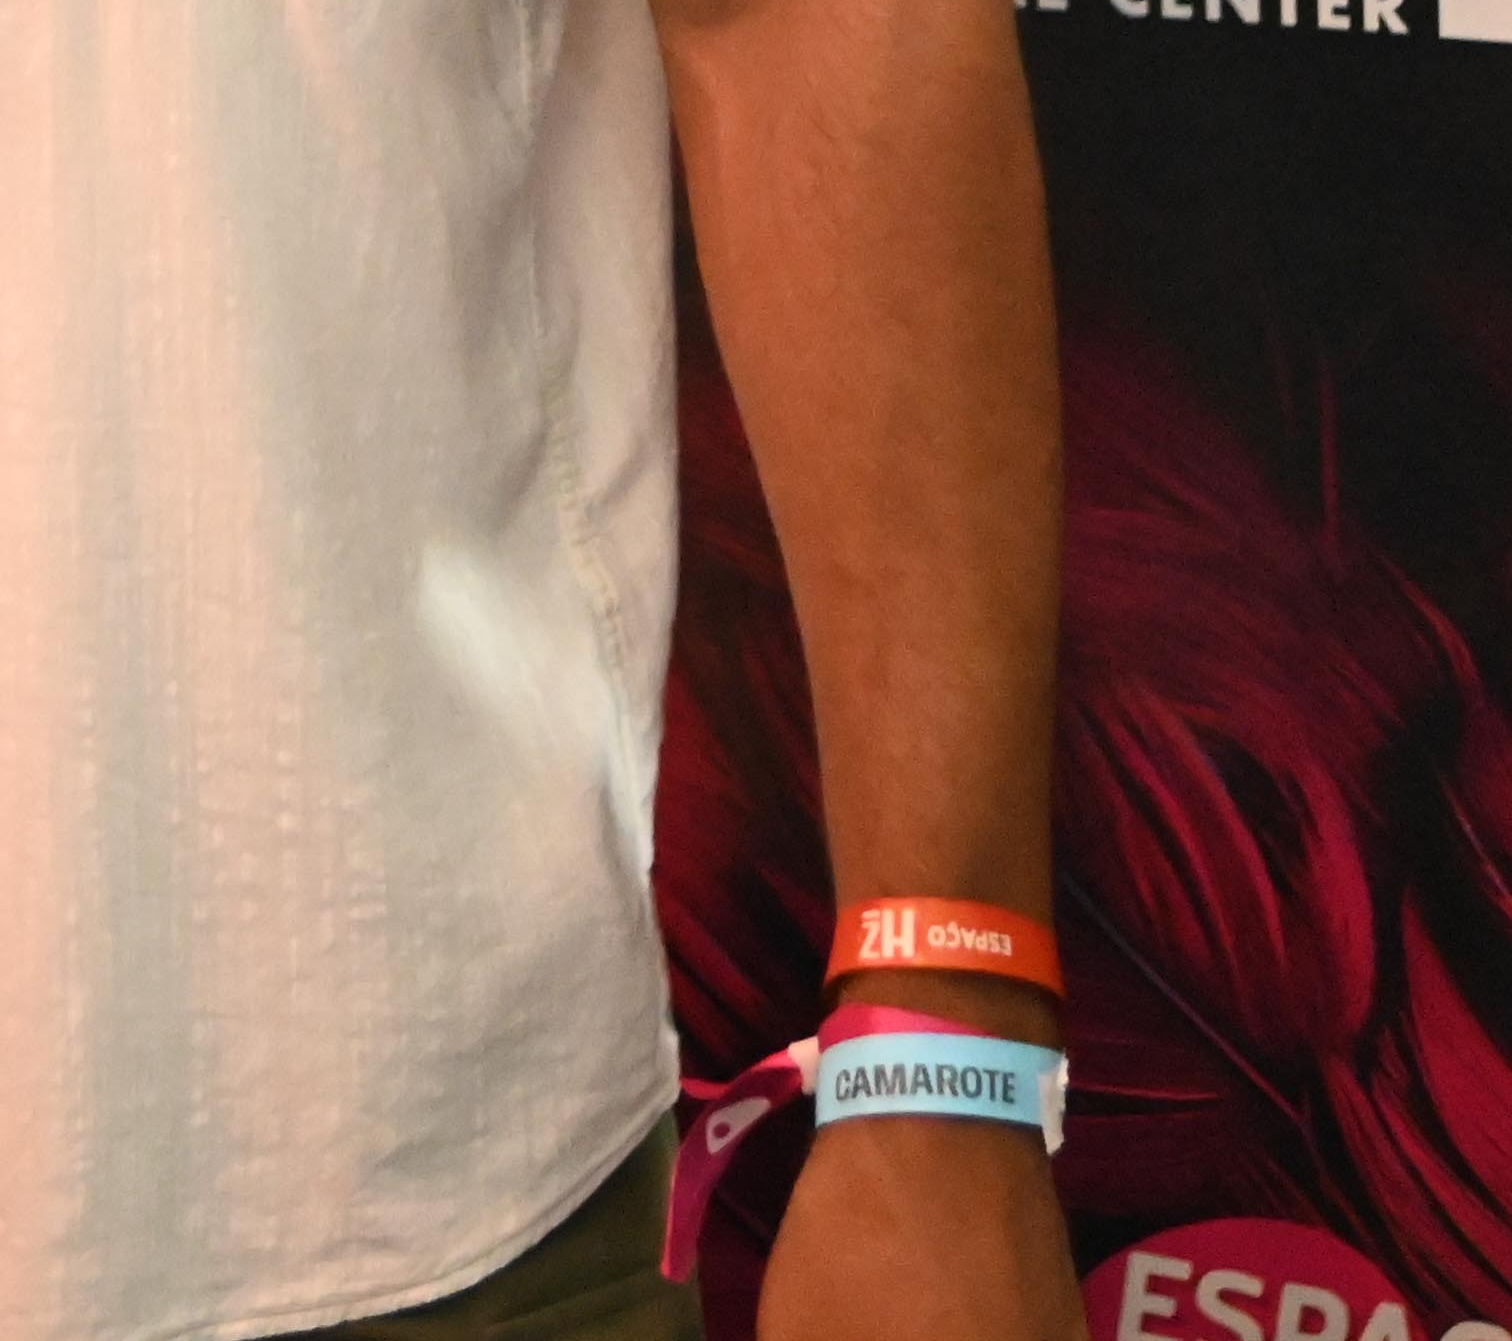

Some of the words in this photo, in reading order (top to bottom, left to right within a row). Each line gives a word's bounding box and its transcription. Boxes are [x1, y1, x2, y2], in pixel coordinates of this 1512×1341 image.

[859, 907, 916, 961] HZ
[927, 920, 1012, 957] ESPAÇO
[834, 1063, 1016, 1105] CAMAROTE
